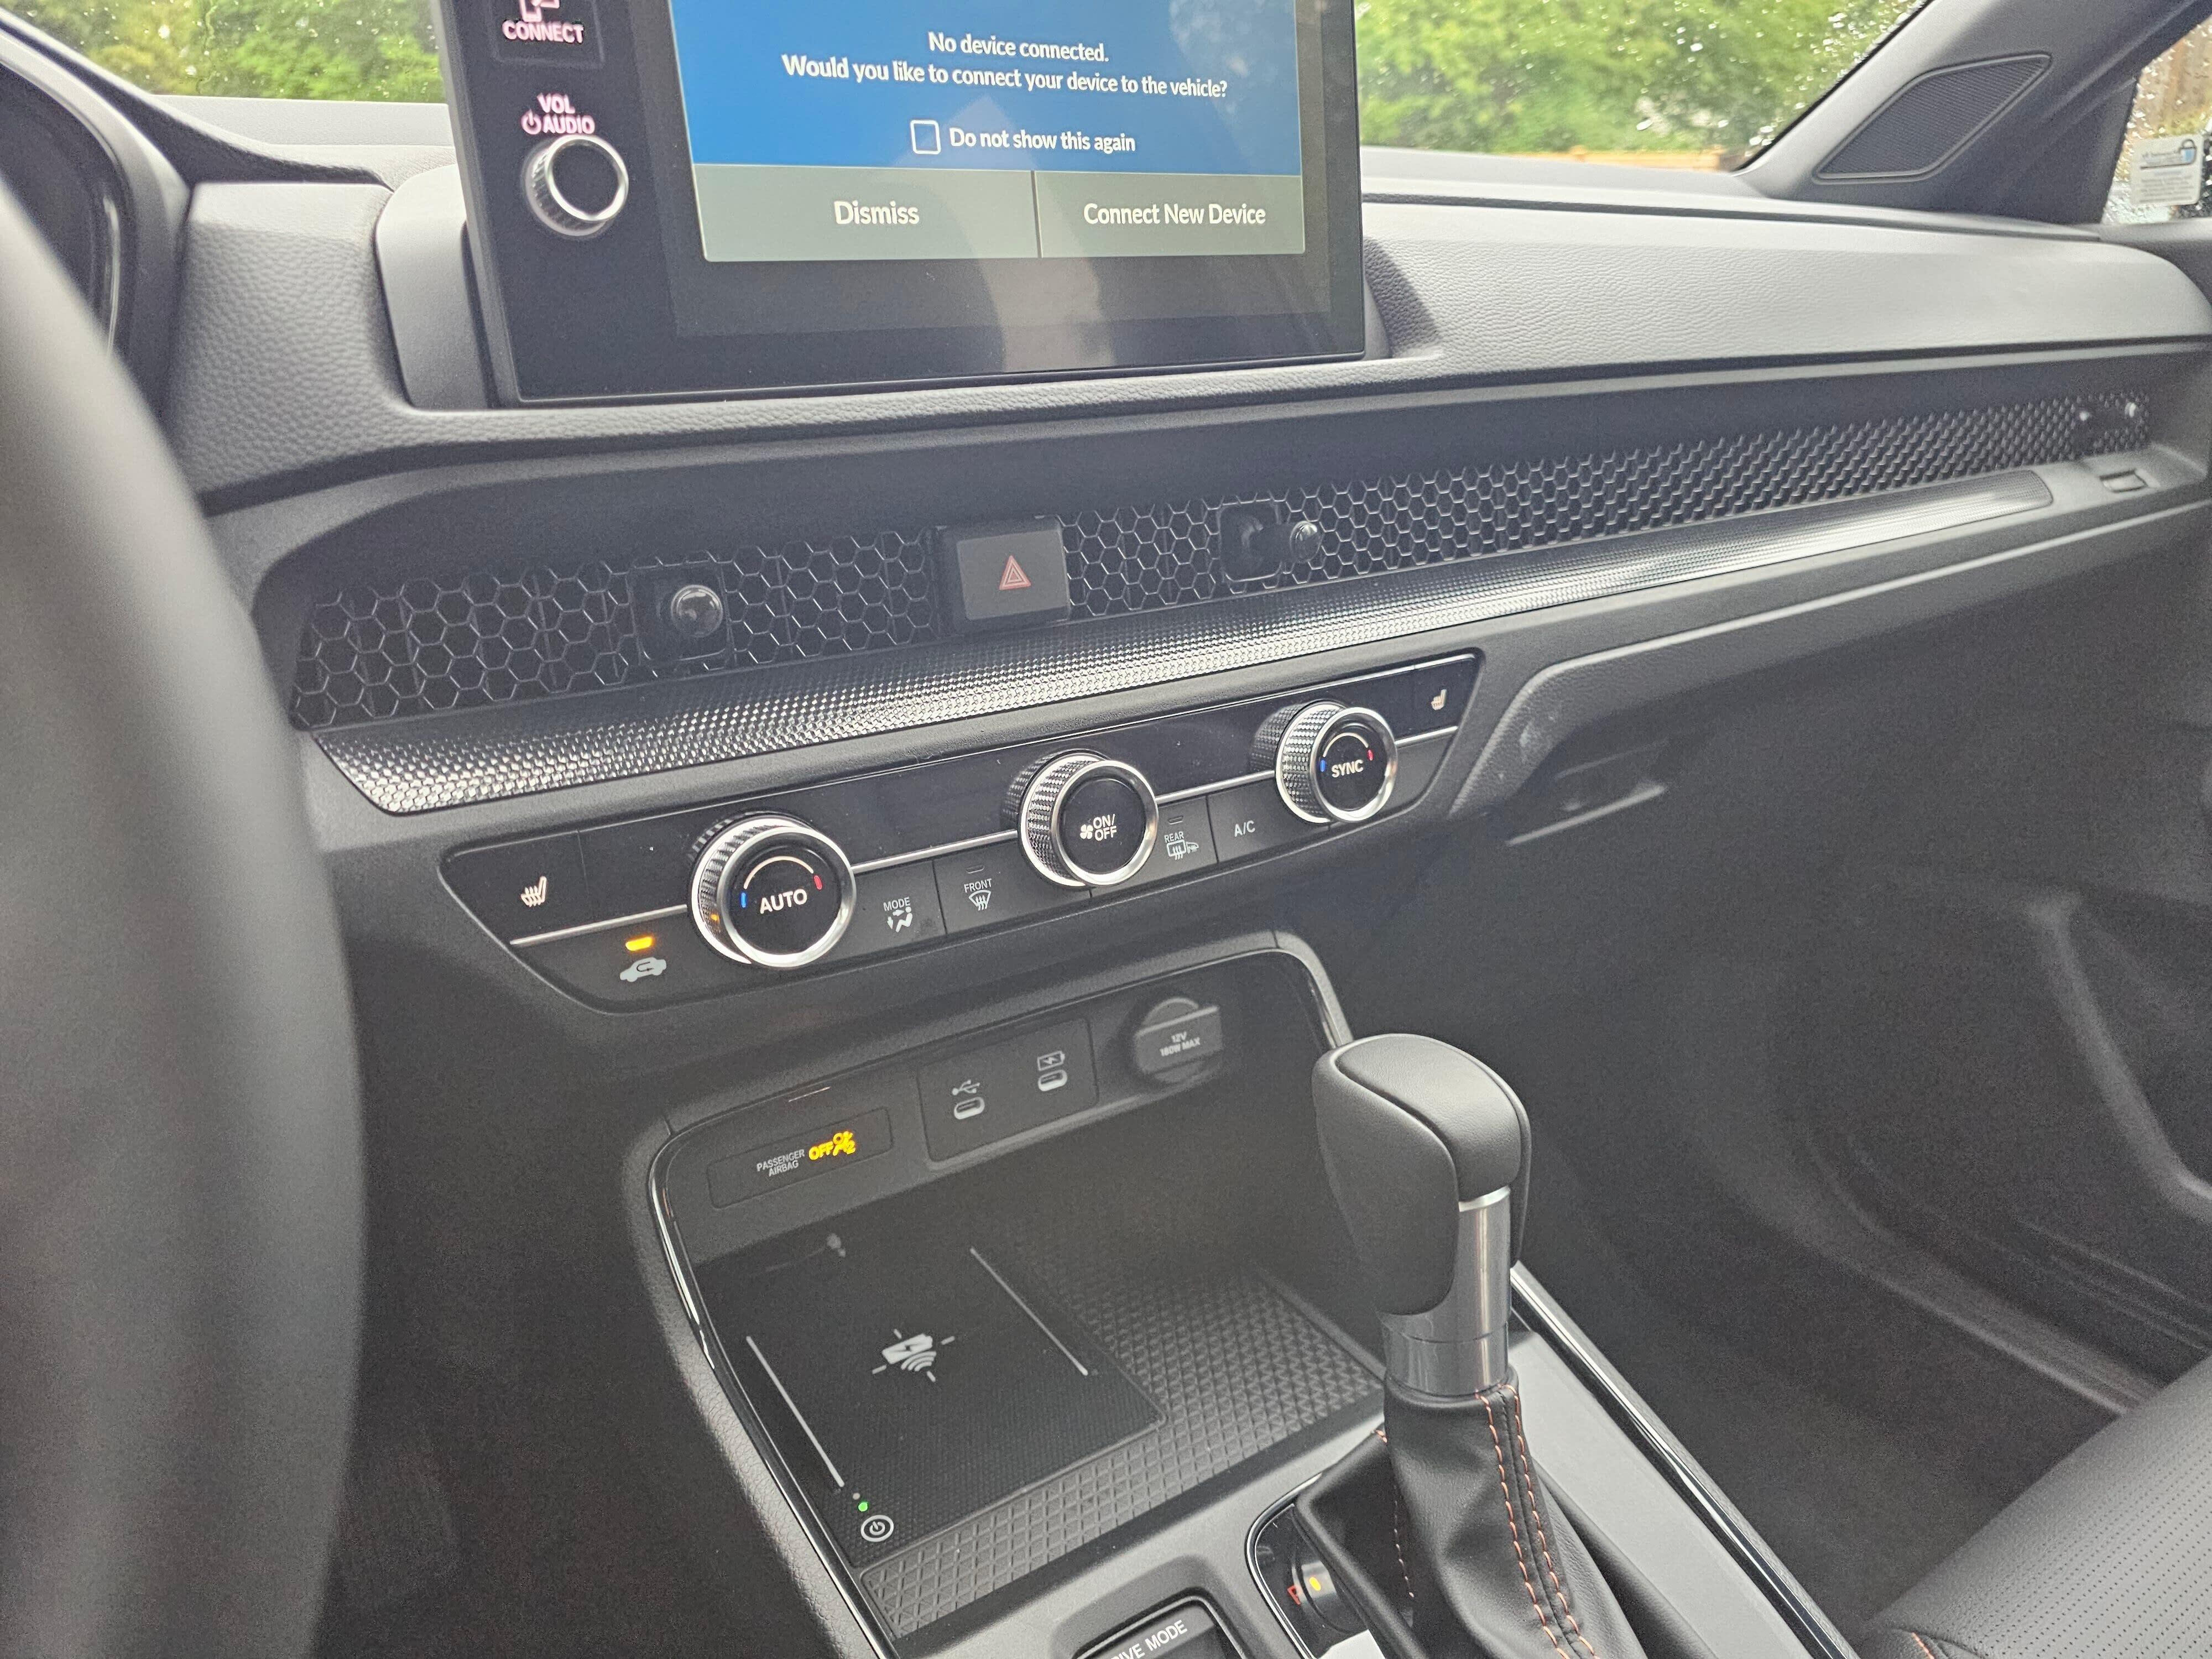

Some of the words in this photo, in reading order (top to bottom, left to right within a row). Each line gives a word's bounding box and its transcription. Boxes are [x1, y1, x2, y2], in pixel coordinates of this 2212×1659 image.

[502, 20, 584, 43] CONNECT
[928, 32, 956, 54] No
[959, 34, 1016, 58] device
[1019, 40, 1110, 62] connected.
[781, 54, 849, 79] Would
[852, 60, 889, 84] you
[892, 60, 925, 84] like
[928, 65, 947, 85] to
[952, 66, 1022, 88] connect
[1025, 72, 1063, 92] your
[1067, 71, 1119, 93] device
[1121, 75, 1139, 94] to
[1141, 75, 1168, 95] the
[1170, 79, 1228, 98] vehicle?
[537, 93, 576, 114] VOL
[542, 115, 595, 134] AUDIO
[950, 127, 977, 148] Do
[979, 129, 1010, 149] not
[1013, 129, 1057, 150] show
[1060, 132, 1092, 151] this
[1093, 134, 1136, 154] again
[833, 200, 920, 225] Dismiss
[1083, 203, 1159, 225] Connect
[1164, 204, 1207, 225] New
[1209, 204, 1266, 225] Device
[1331, 758, 1364, 779] SYNC
[1093, 813, 1117, 830] ON/
[1234, 820, 1256, 838] A/C
[1094, 826, 1118, 842] OFF
[1164, 832, 1185, 844] REAR
[963, 878, 993, 893] FRONT
[759, 889, 808, 914] AUTO
[883, 896, 911, 911] MODE
[1172, 1031, 1187, 1043] 12V
[1182, 1037, 1201, 1050] MAX
[756, 1149, 805, 1172] PASSENGER
[808, 1141, 834, 1160] OFF
[768, 1160, 799, 1177] AIRBAG
[1145, 1619, 1188, 1651] MODE
